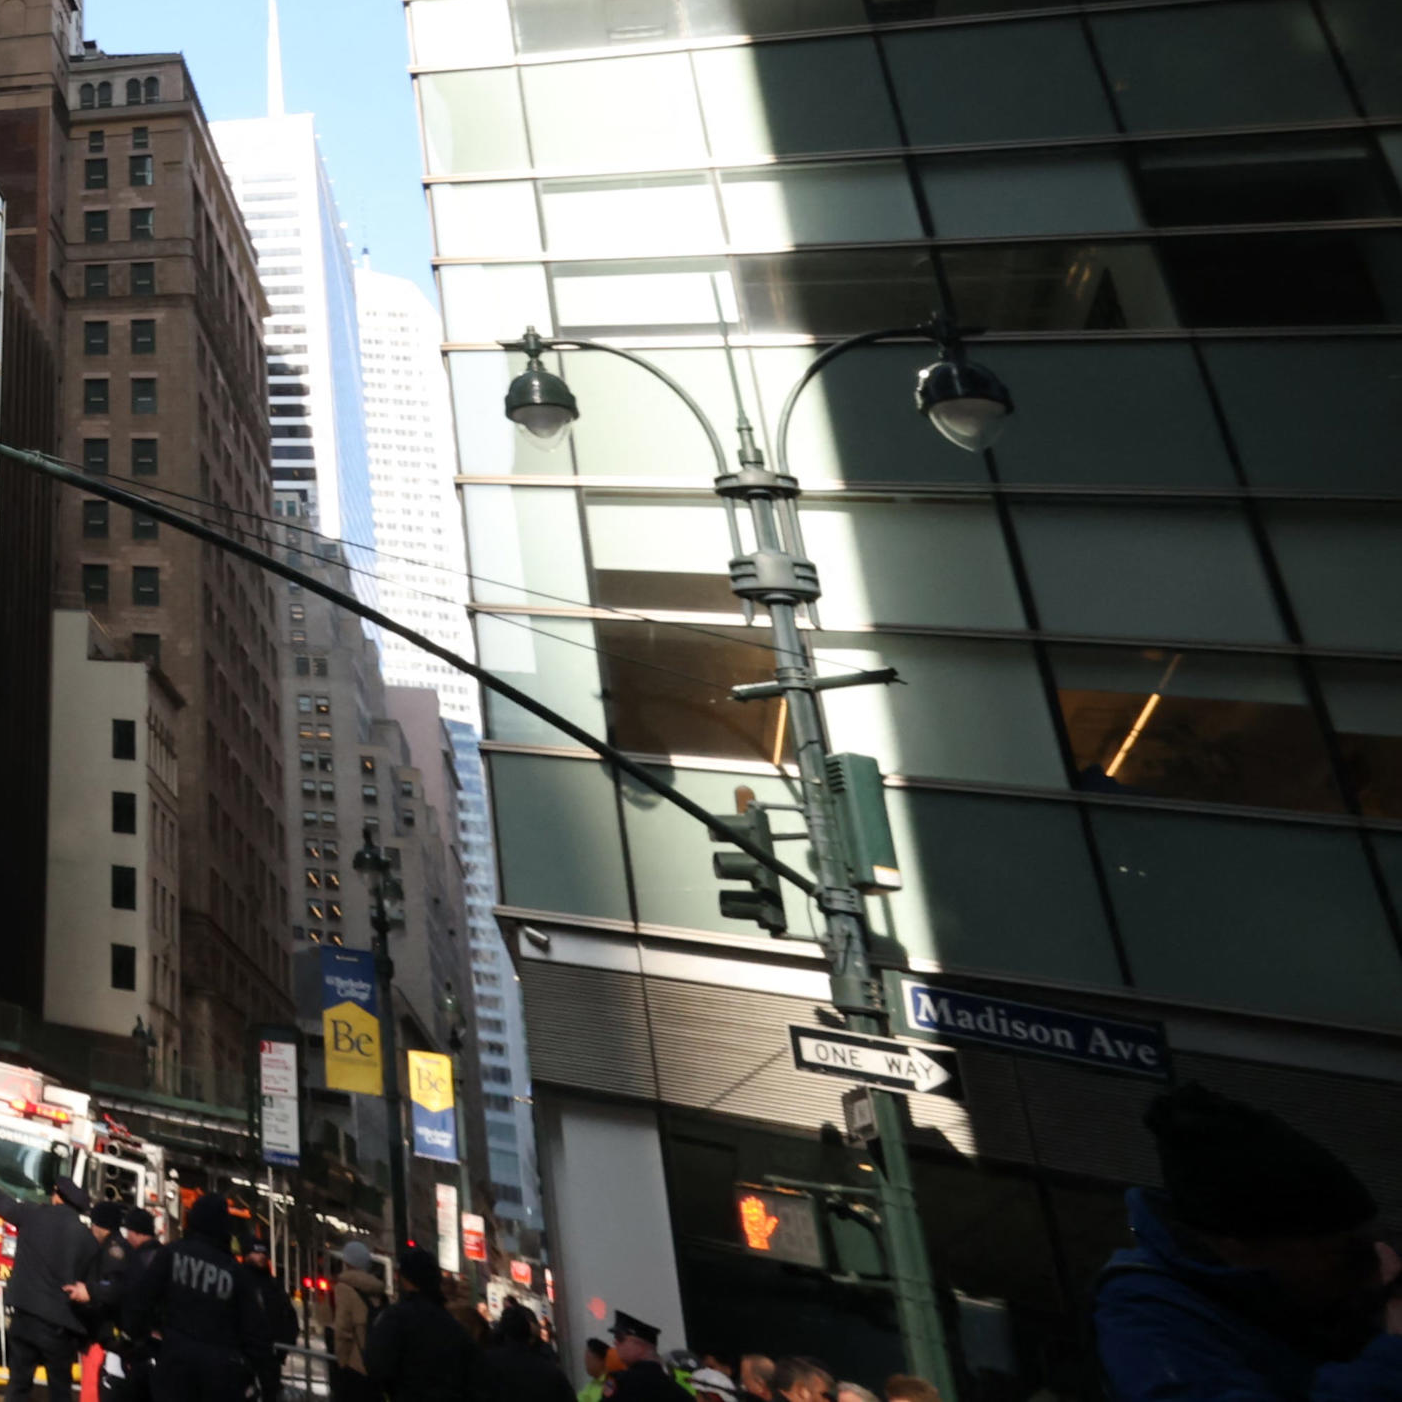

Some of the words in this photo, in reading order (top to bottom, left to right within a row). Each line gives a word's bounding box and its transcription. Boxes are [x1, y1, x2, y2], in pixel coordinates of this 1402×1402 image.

[331, 1020, 374, 1057] Be
[916, 993, 1076, 1050] Madison
[1088, 1027, 1158, 1066] Ave
[814, 1043, 863, 1068] ONE
[884, 1055, 936, 1081] WAY
[172, 1251, 234, 1300] NYPD
